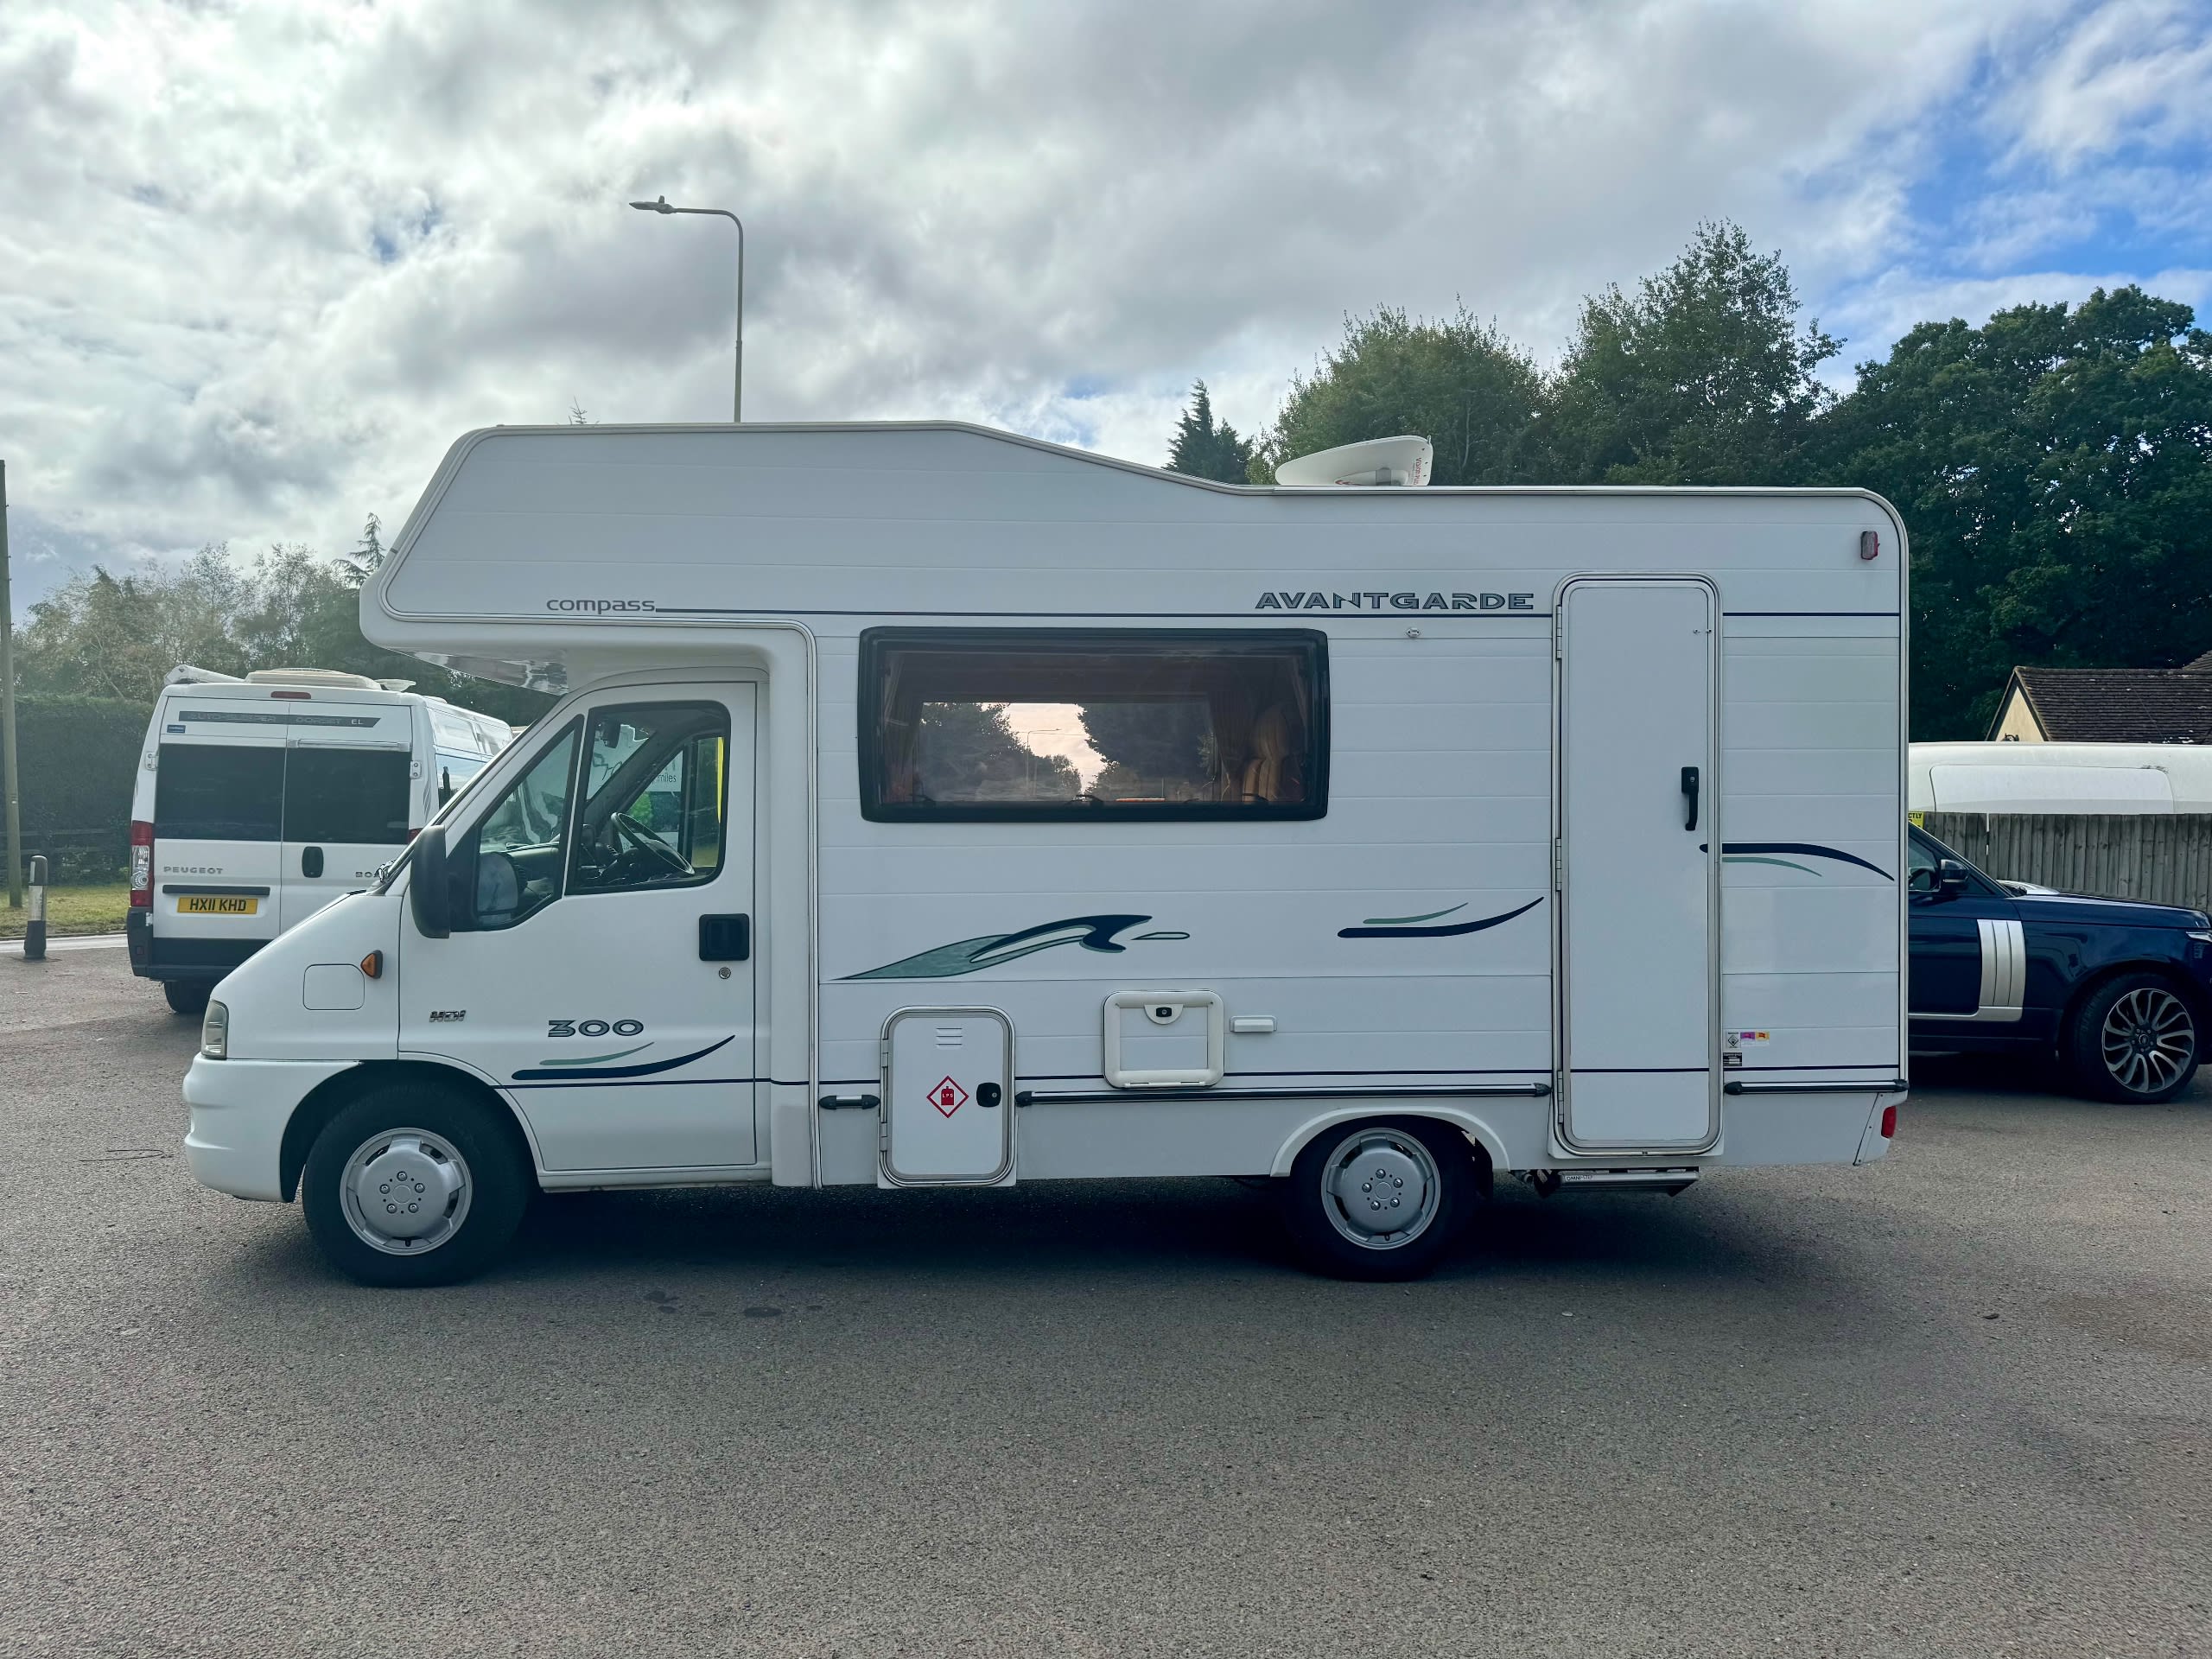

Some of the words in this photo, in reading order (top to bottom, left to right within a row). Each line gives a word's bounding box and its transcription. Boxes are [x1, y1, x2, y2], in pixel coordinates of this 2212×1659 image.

[546, 600, 655, 614] compass
[1255, 592, 1535, 609] AVANTGARDE
[162, 866, 223, 874] PEUGEOT
[189, 898, 216, 911] HX11
[219, 899, 247, 912] KHD
[548, 1020, 644, 1038] 300
